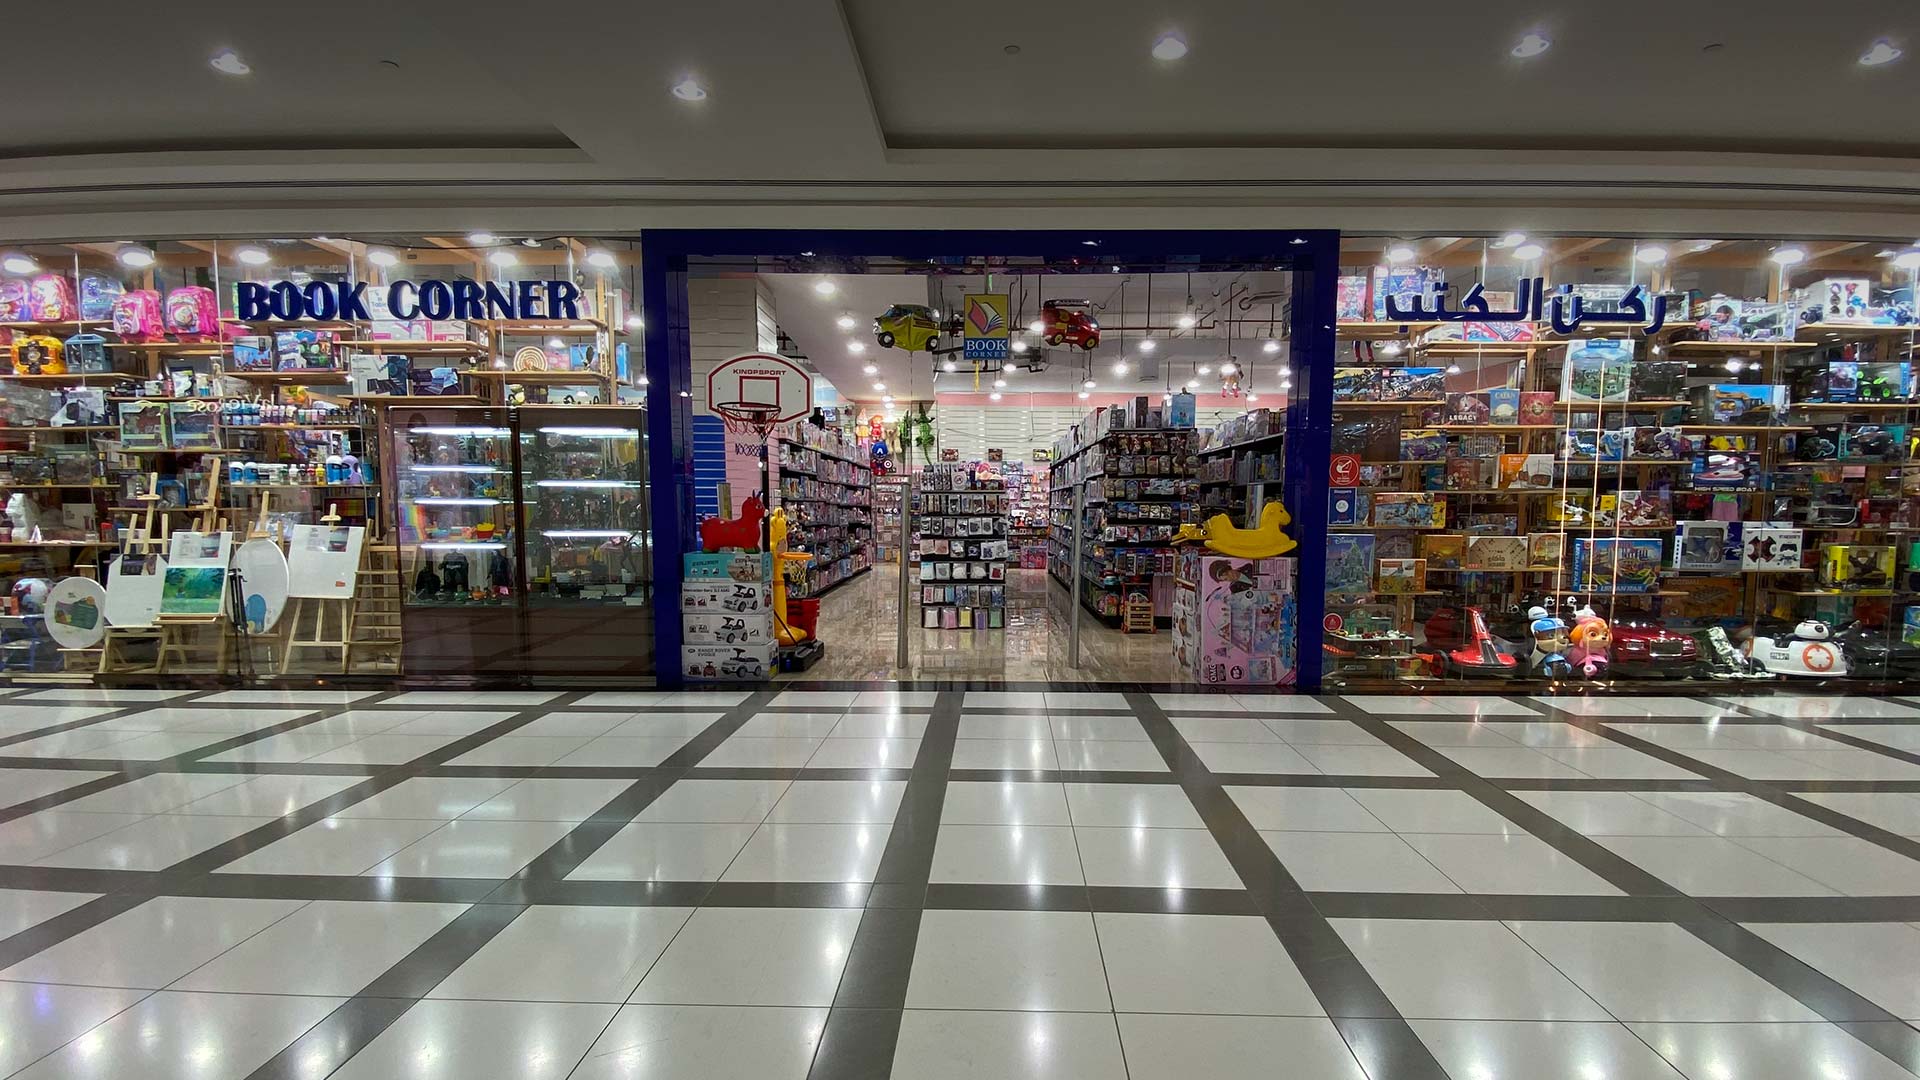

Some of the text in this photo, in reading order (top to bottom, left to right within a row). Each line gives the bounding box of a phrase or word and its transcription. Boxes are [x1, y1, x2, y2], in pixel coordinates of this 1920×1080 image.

[238, 280, 582, 321] BOOK CORNER
[1385, 277, 1545, 334] الكتب
[1552, 284, 1668, 336] ركن
[966, 340, 1007, 351] BOOK
